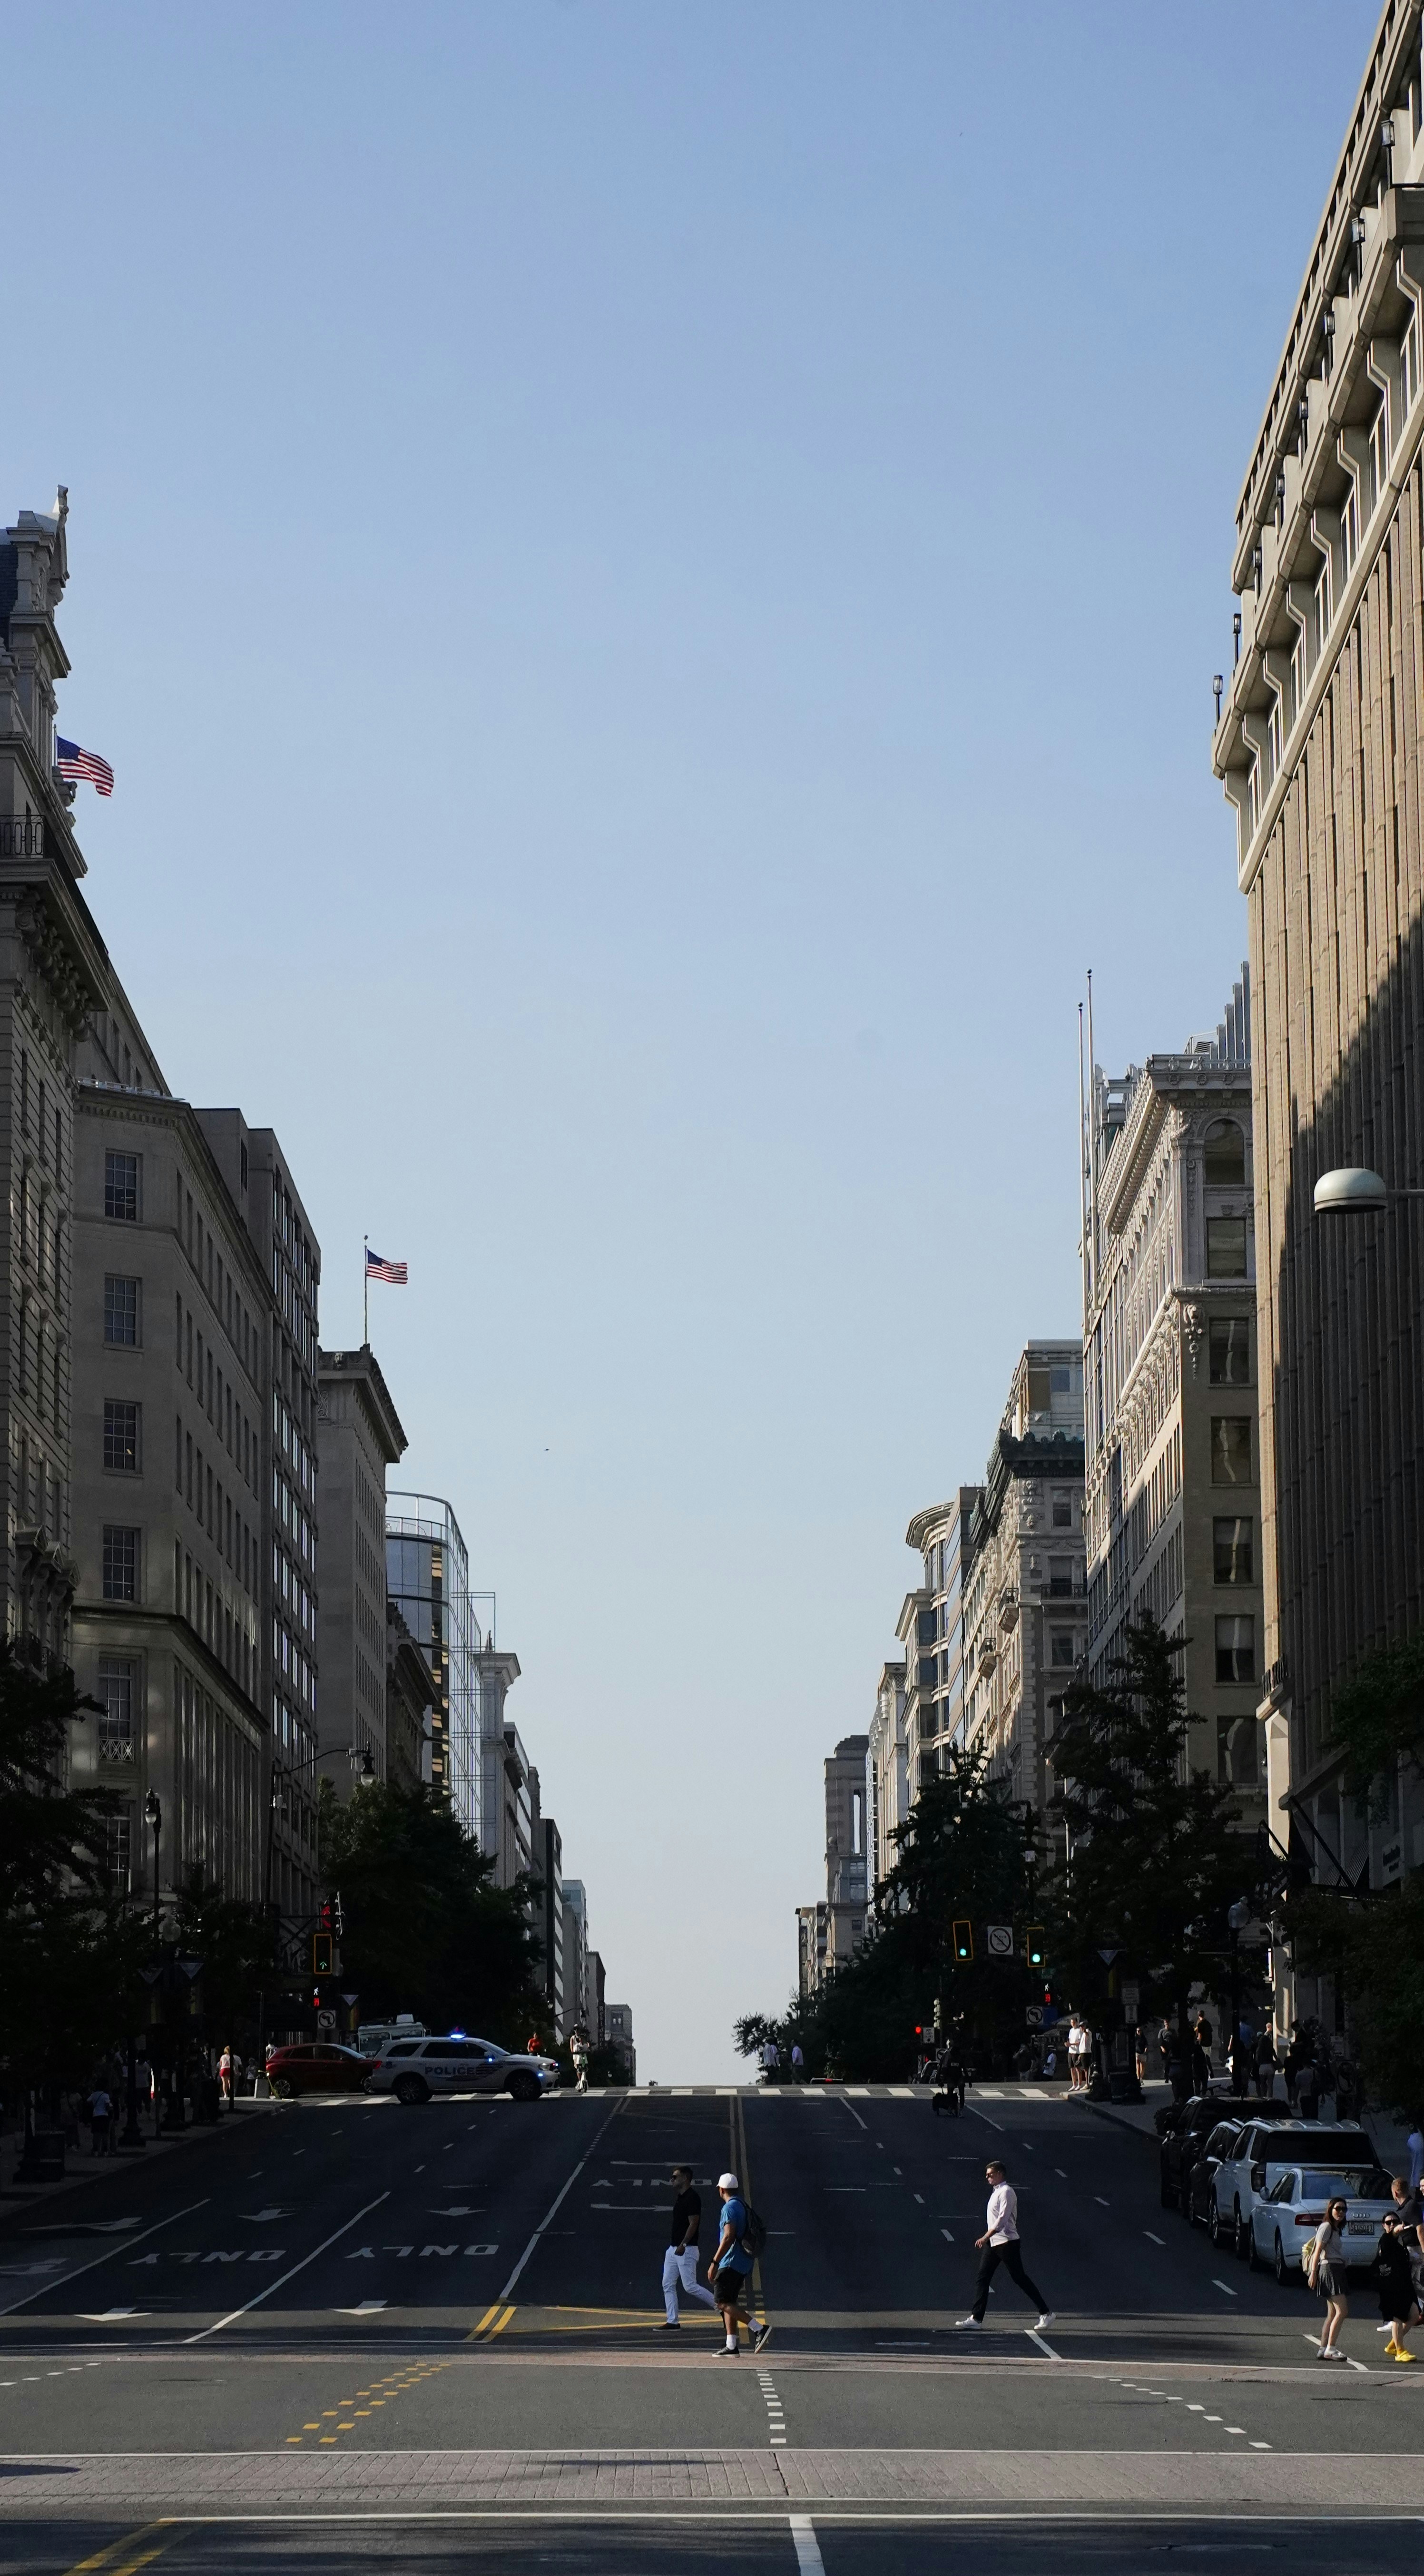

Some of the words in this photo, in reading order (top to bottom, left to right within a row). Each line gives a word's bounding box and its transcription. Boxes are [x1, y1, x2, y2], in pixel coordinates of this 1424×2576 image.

[425, 2066, 475, 2075] POLICE
[126, 2250, 287, 2264] ONLY
[344, 2244, 499, 2258] ONLY
